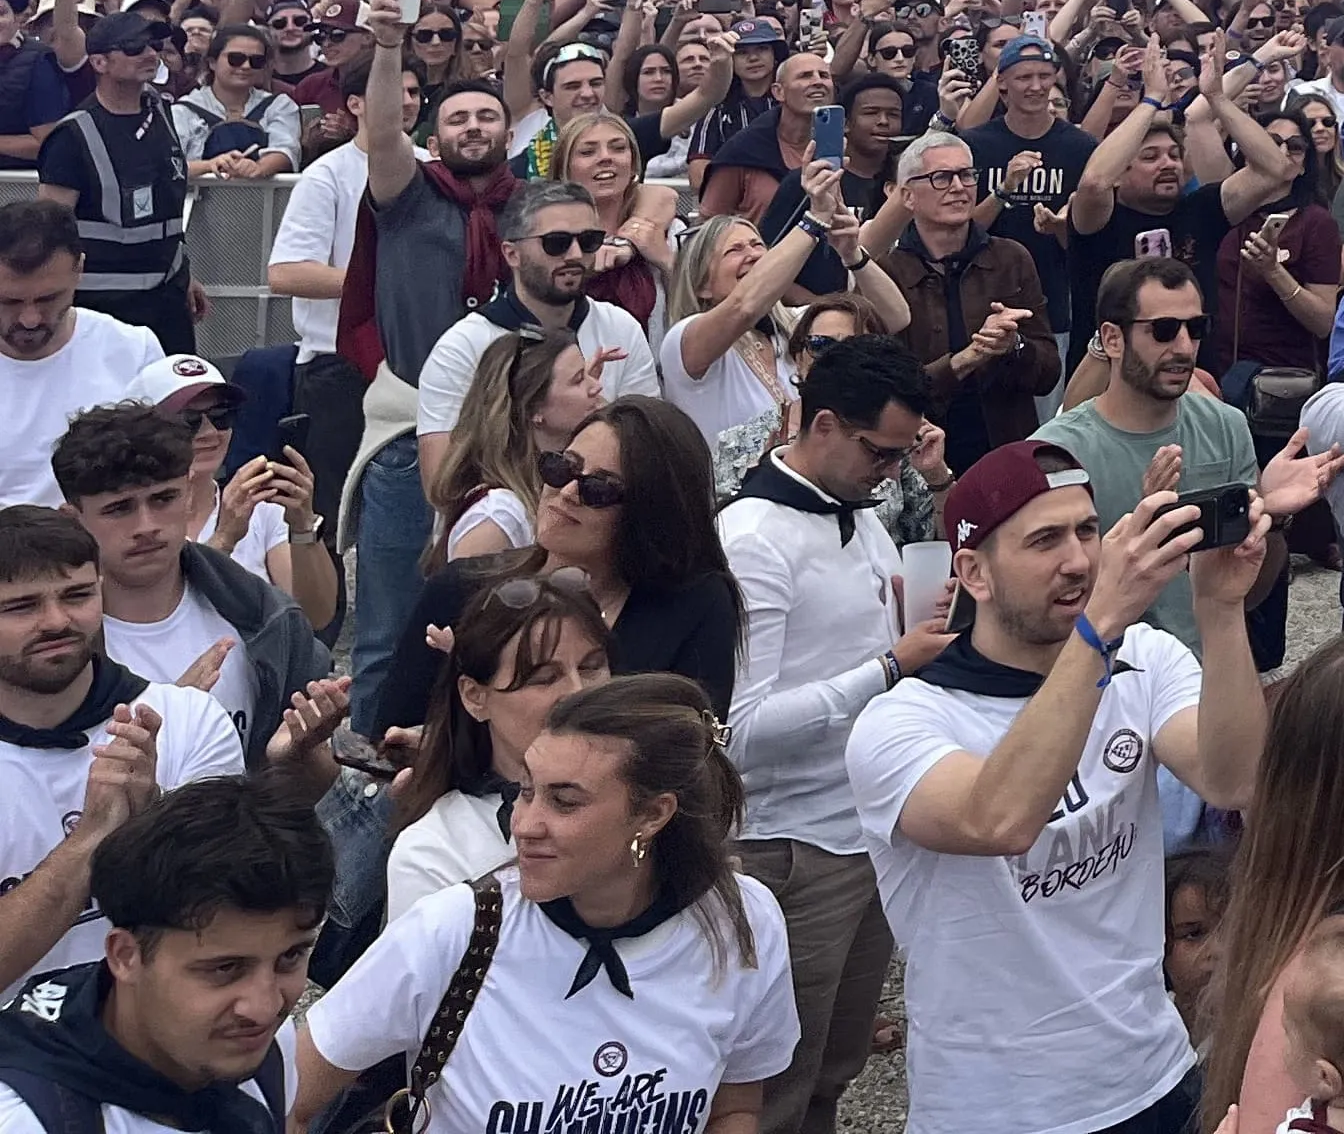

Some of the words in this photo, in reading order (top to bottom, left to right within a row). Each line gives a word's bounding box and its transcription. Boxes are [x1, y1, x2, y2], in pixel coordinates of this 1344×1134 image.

[988, 167, 1063, 194] UION
[1020, 823, 1138, 903] BORDEAU
[545, 1079, 600, 1124] WE
[611, 1068, 668, 1112] ARE
